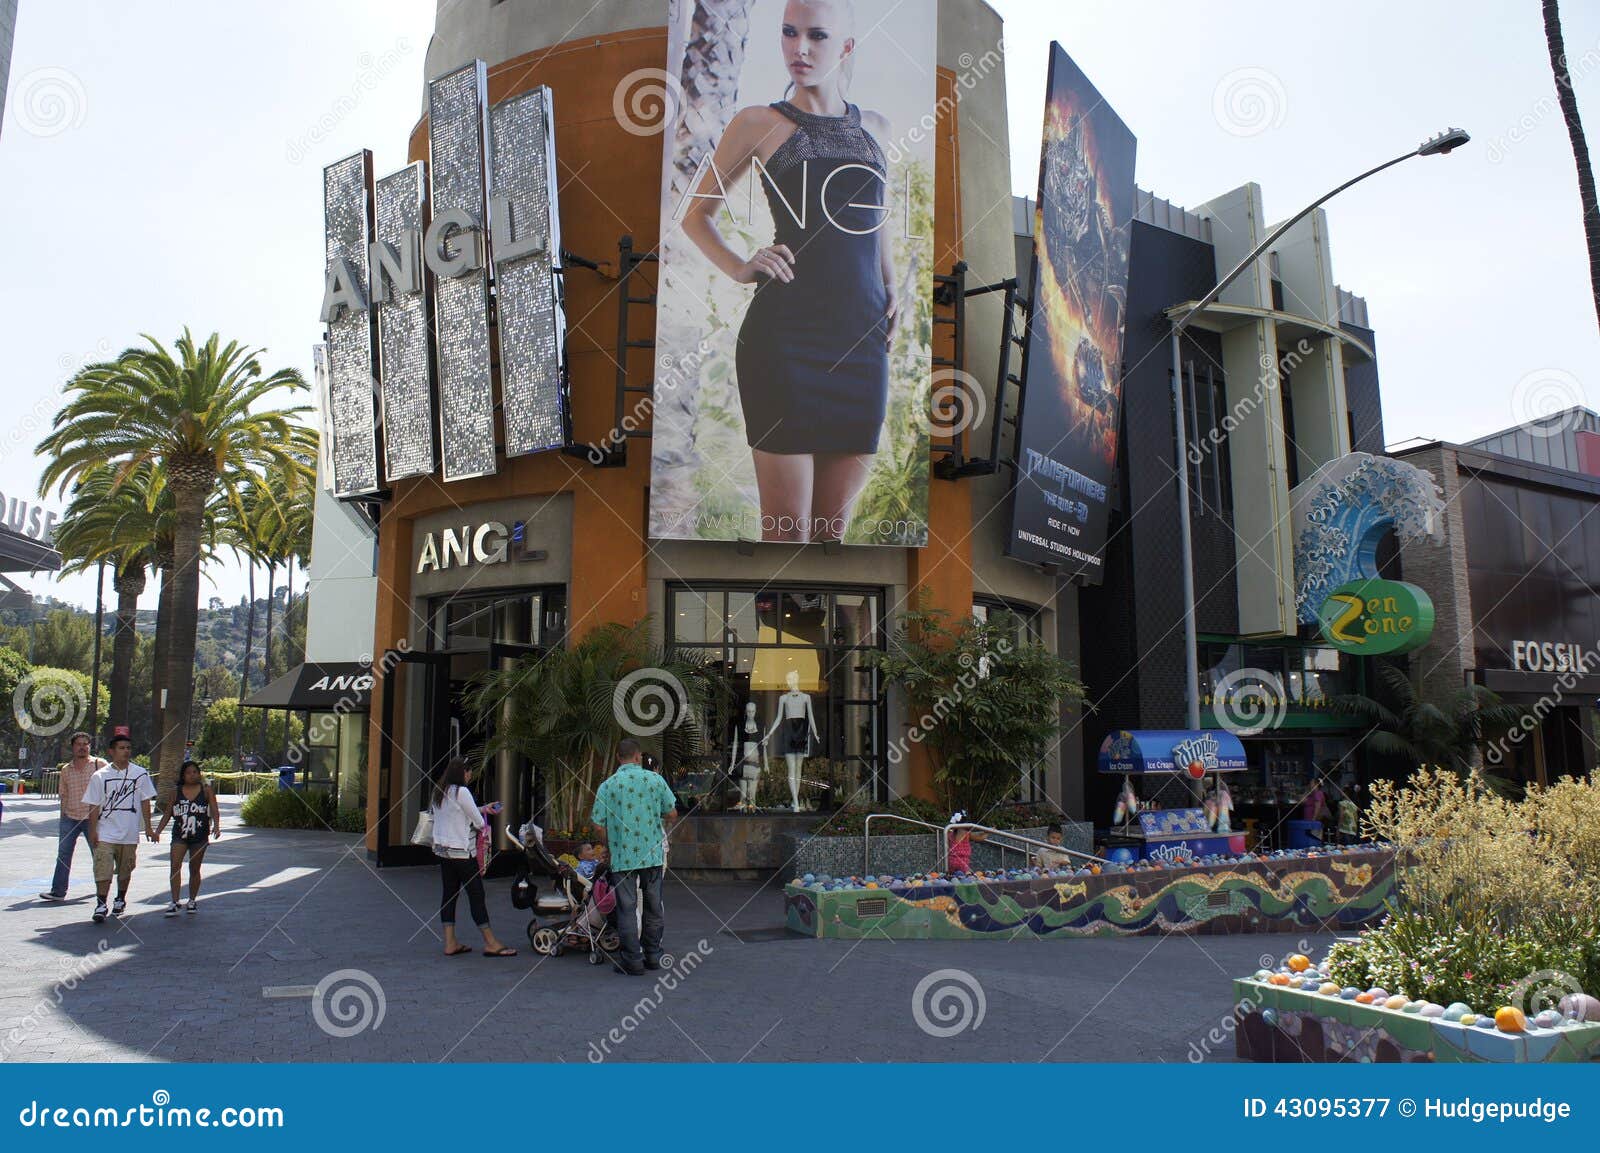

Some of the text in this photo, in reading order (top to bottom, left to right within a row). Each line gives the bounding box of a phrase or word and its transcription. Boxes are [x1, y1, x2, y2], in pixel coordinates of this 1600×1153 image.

[671, 152, 925, 241] ANGL
[320, 195, 547, 323] ANGL
[1026, 447, 1106, 503] TRANSFORMERS
[1047, 517, 1061, 530] RIDE
[1067, 525, 1081, 538] NOW
[416, 520, 547, 574] ANGL
[1018, 529, 1102, 566] UNIVERSAL STUDIOS HOLLYWOOD
[1512, 640, 1588, 673] FOSSIL
[1109, 762, 1118, 770] Ice
[1147, 760, 1175, 769] Ice Cream
